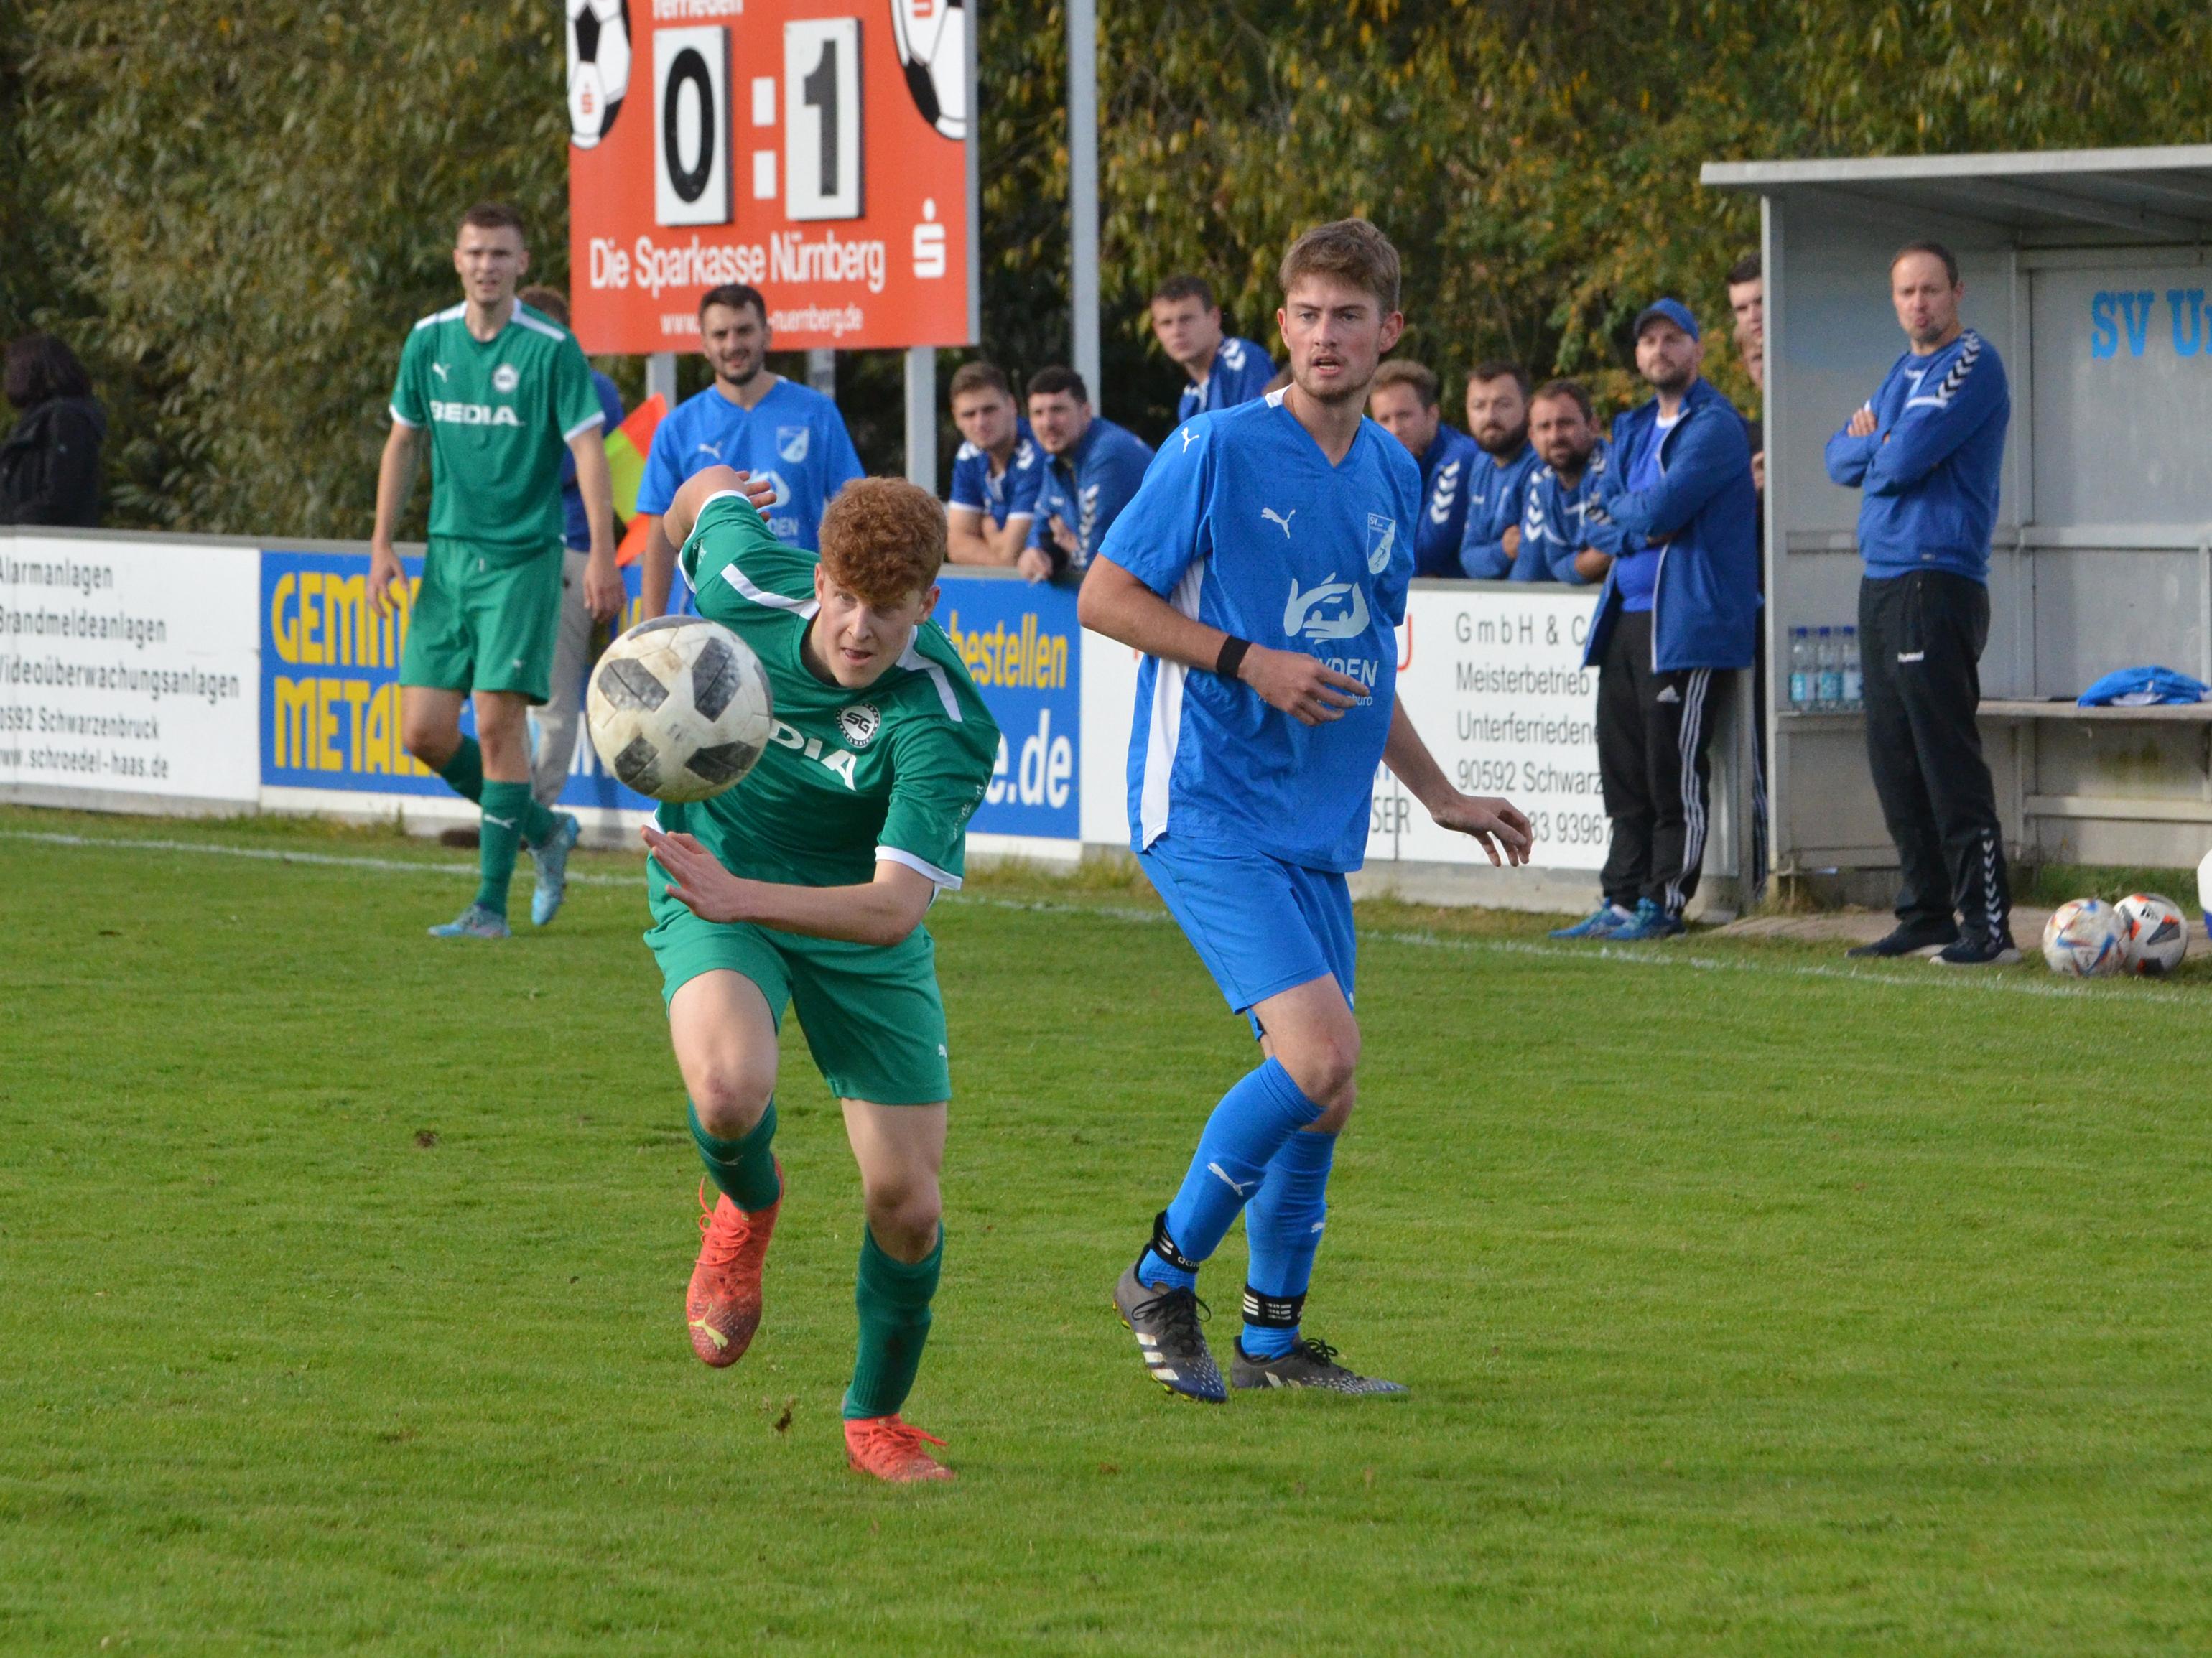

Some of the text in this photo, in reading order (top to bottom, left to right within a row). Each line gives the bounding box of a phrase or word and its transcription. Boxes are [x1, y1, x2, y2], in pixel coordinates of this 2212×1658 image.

[590, 230, 885, 299] Die Sparkasse Nürnberg
[2091, 289, 2155, 358] SV
[272, 572, 422, 668] GEMM
[1456, 661, 1591, 697] Meisterbetrieb
[39, 706, 159, 740] Schwarzenbruck
[1457, 709, 1599, 745] Unterferrieden
[1458, 758, 1516, 792] 90592
